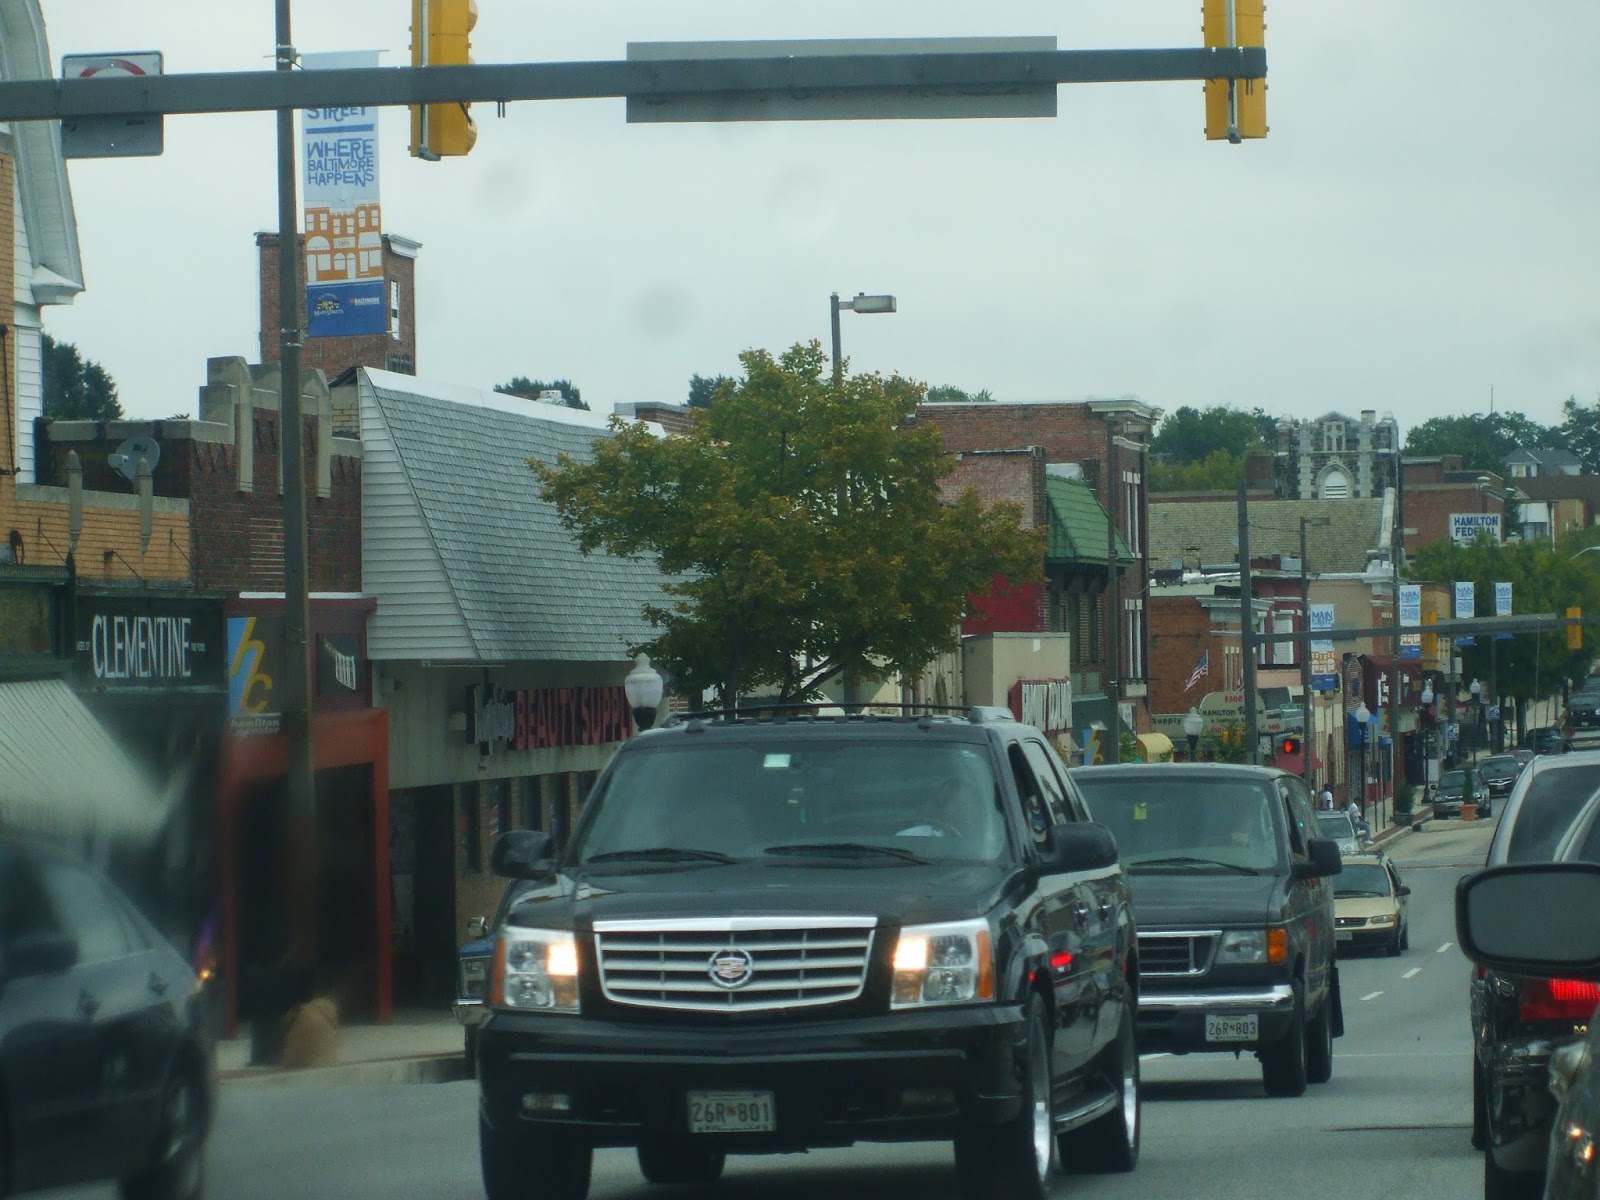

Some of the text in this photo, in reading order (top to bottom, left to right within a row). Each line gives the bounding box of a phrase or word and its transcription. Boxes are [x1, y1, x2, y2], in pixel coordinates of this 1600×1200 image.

[307, 138, 374, 159] WHERE
[307, 156, 374, 173] BALTIMORE
[307, 168, 374, 187] HAPPENS
[1454, 516, 1498, 528] HAMILTON
[1455, 526, 1497, 537] FEDEAL
[1311, 610, 1333, 621] MAIN
[91, 614, 192, 679] CLEMENTINE
[514, 687, 577, 750] BEAUTY
[1151, 717, 1183, 725] Supply
